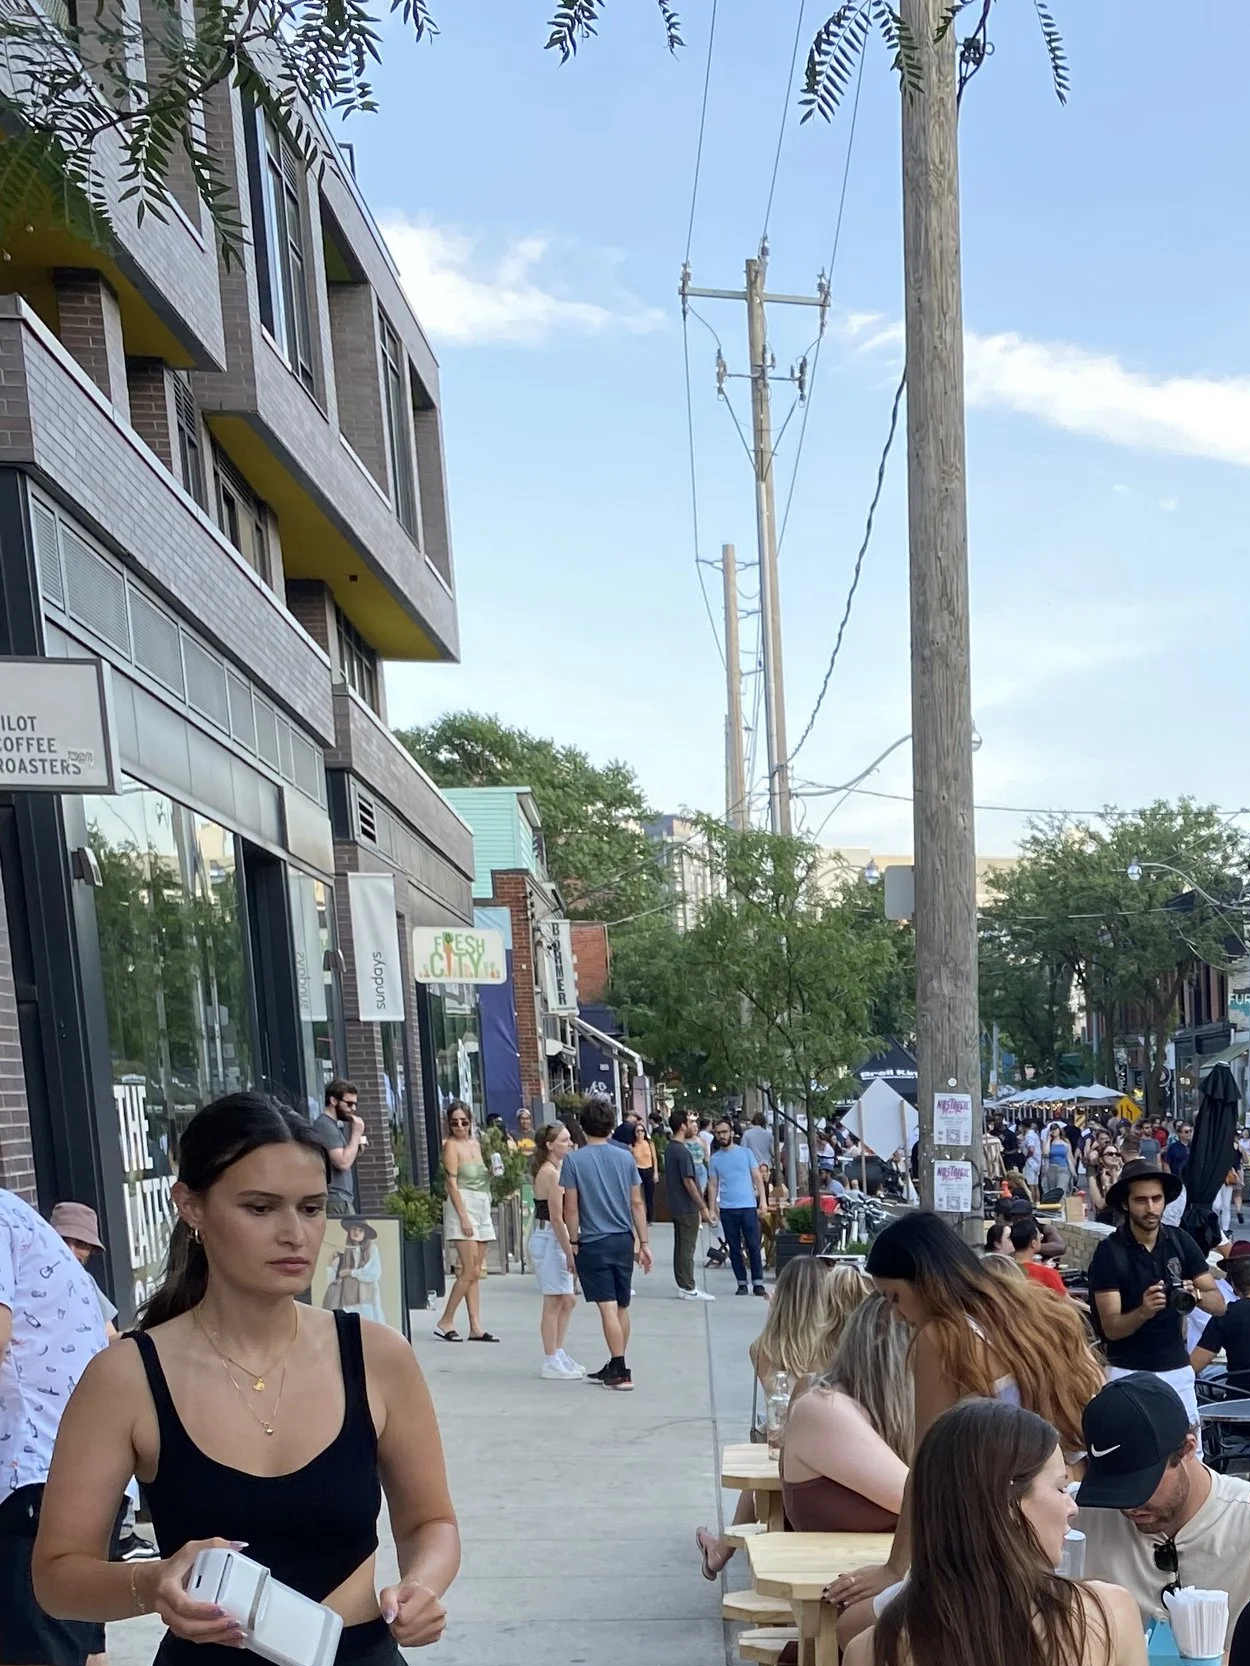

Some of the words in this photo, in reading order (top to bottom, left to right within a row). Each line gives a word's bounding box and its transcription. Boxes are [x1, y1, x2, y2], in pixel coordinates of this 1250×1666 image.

[0, 737, 57, 754] OFFEE
[434, 932, 485, 953] FRESH
[429, 950, 484, 978] CITY
[372, 951, 386, 1010] sundays
[113, 1084, 153, 1173] THE
